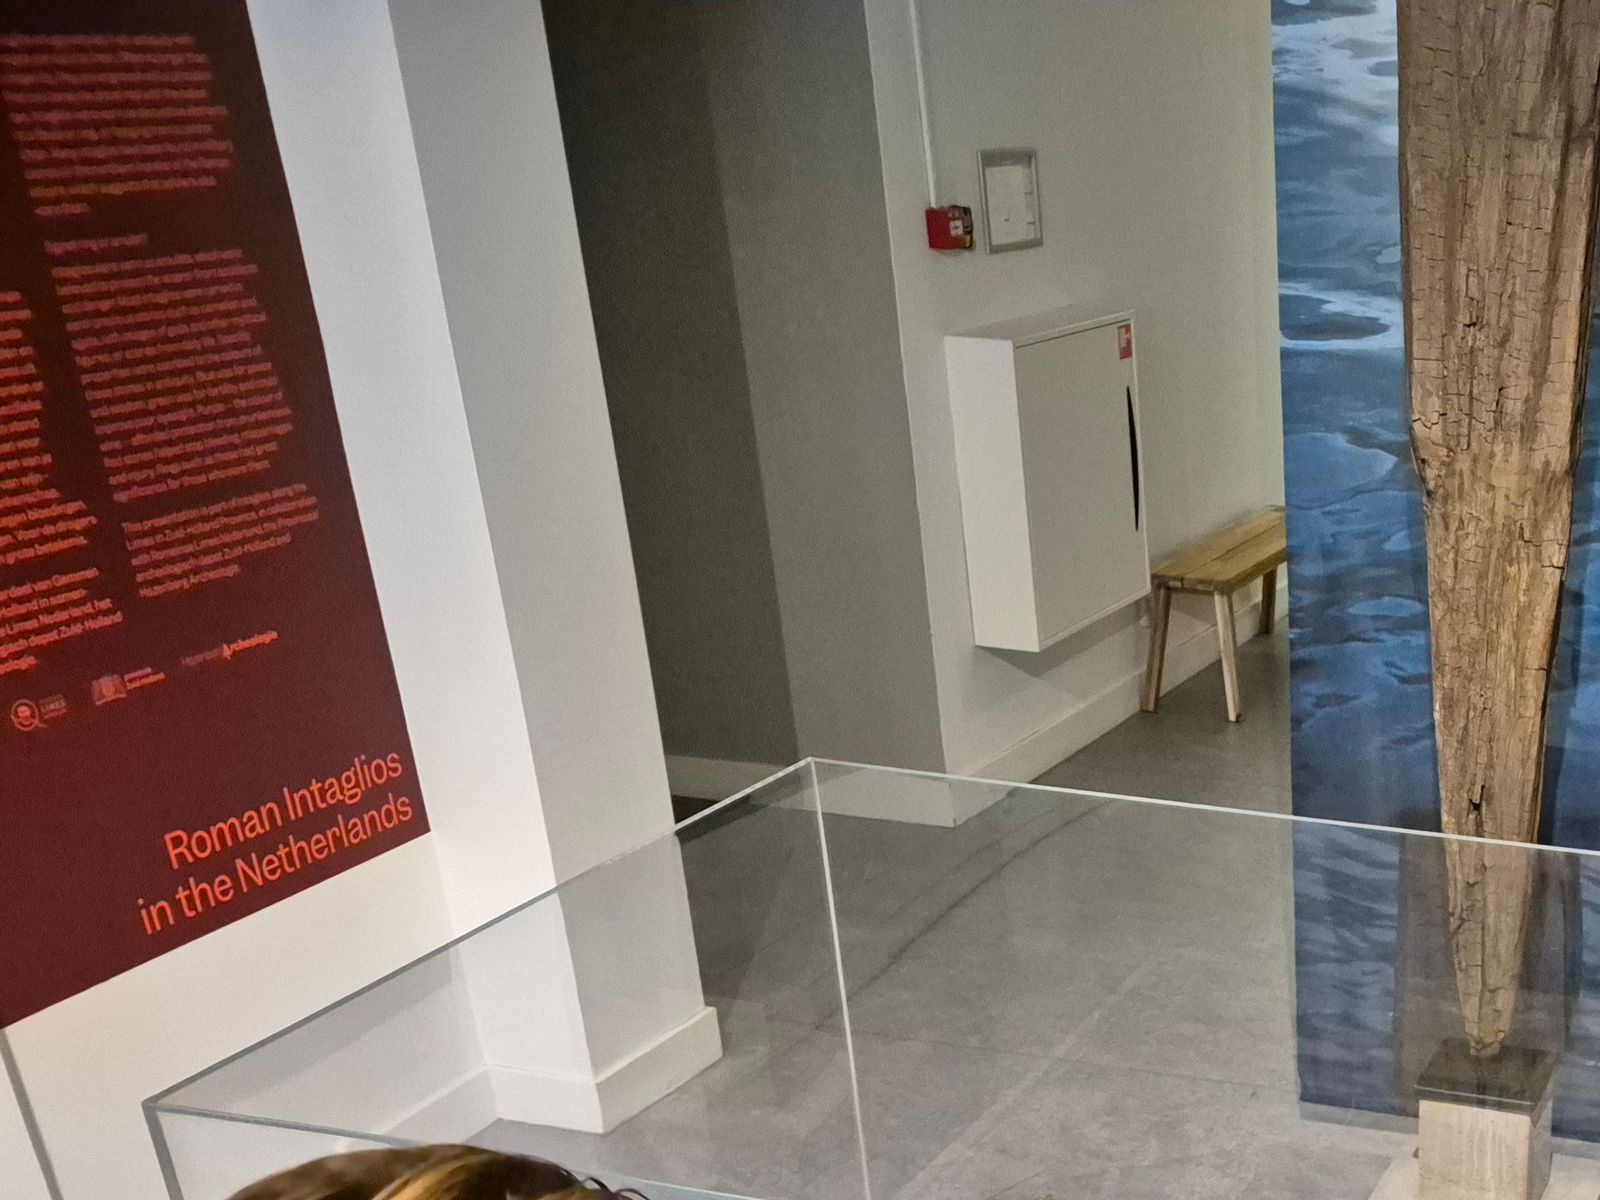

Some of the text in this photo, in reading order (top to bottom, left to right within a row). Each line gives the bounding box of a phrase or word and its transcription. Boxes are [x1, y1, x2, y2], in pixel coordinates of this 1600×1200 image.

[137, 792, 414, 936] in the Netherlands
[163, 752, 403, 870] Roman Intaglios
